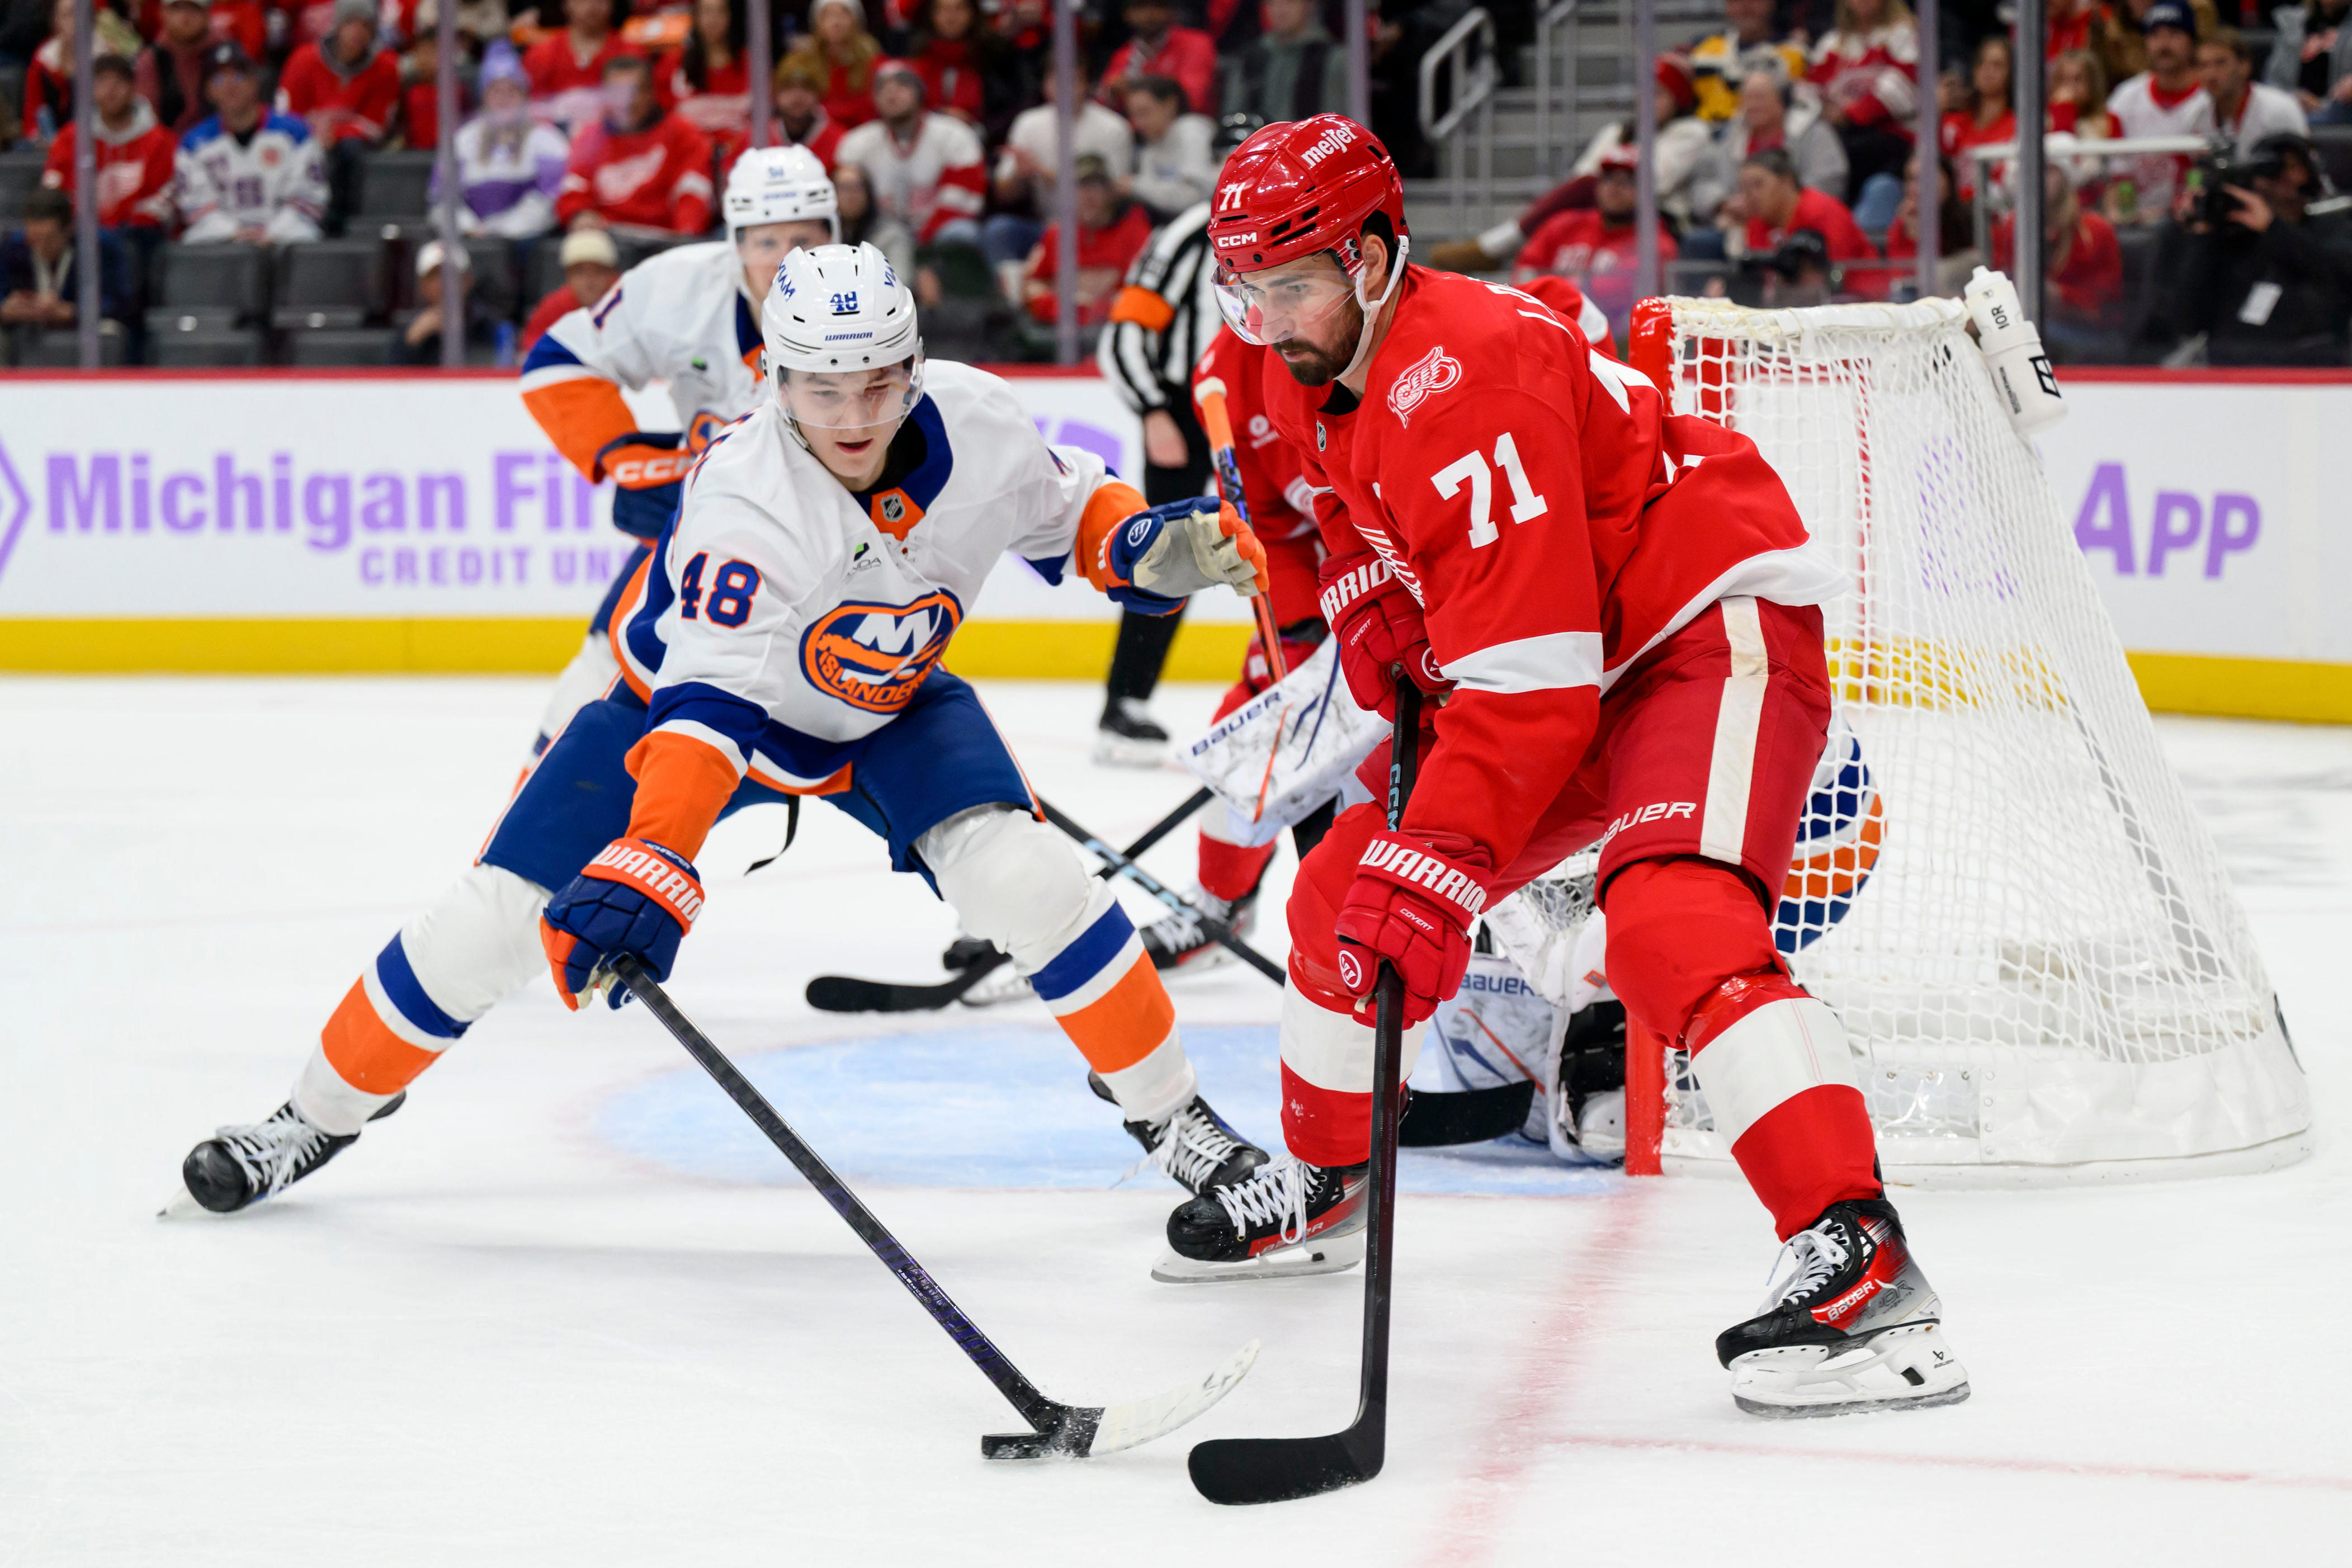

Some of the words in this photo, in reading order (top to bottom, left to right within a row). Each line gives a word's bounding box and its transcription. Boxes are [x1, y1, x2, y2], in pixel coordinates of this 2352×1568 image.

[1301, 125, 1358, 170] meijer
[1219, 182, 1246, 211] 71
[1218, 232, 1257, 247] CCM
[830, 291, 858, 311] 48
[825, 332, 872, 341] WARRIOR
[46, 454, 466, 550] Michigan
[1430, 431, 1548, 549] 71
[360, 545, 531, 587] CREDIT
[681, 550, 762, 629] 48
[1350, 618, 1371, 646] COVERT
[1400, 908, 1434, 931] COVERT
